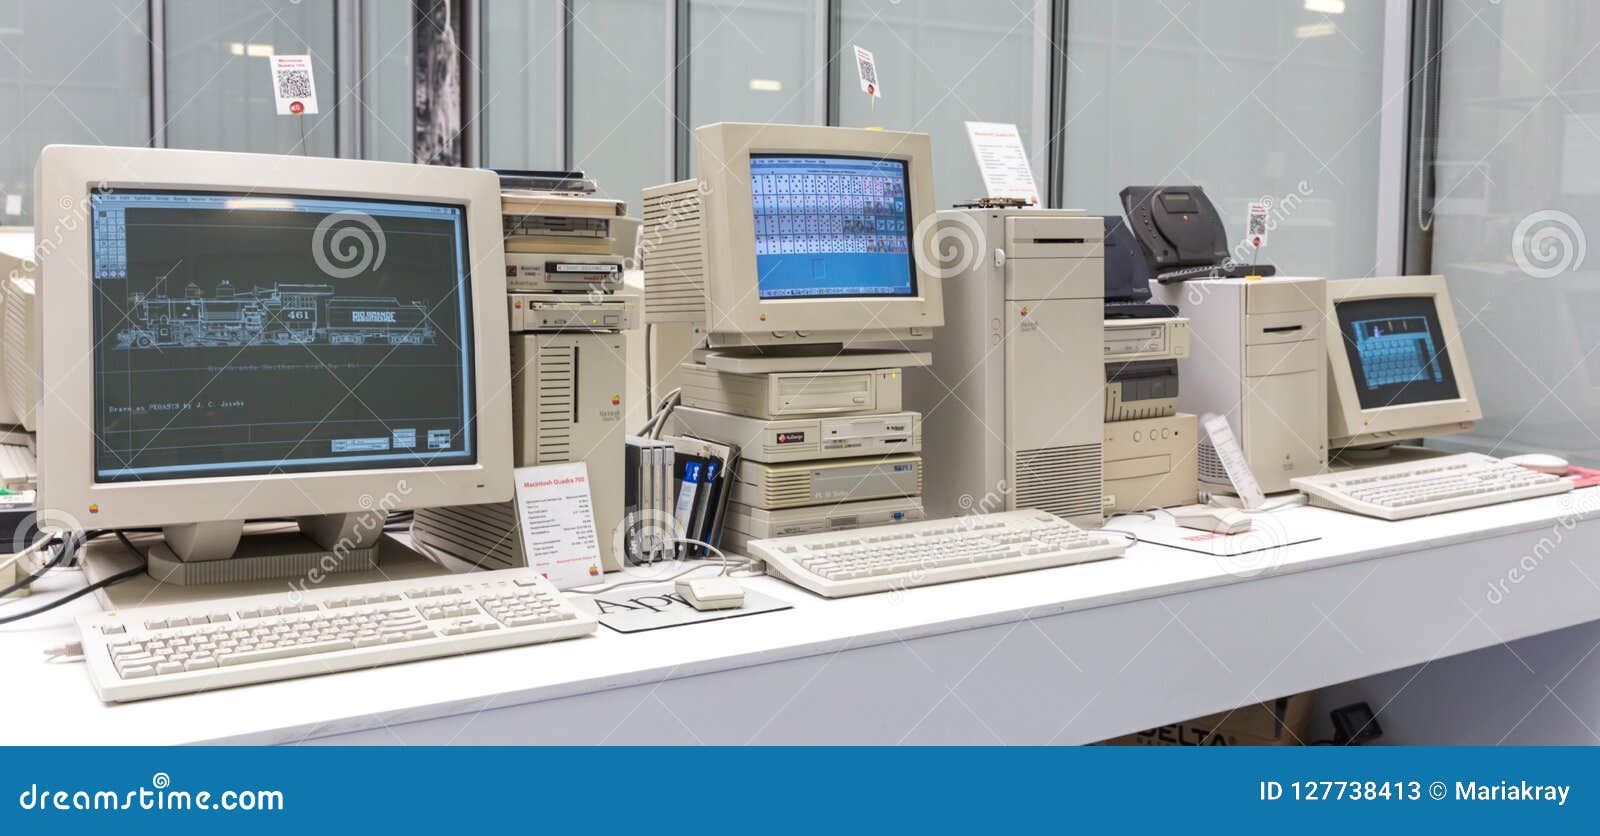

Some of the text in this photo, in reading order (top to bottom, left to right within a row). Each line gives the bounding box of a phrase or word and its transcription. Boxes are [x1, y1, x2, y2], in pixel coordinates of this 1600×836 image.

[287, 310, 309, 320] 461
[523, 479, 553, 488] Macintosh
[553, 477, 574, 486] Quadra
